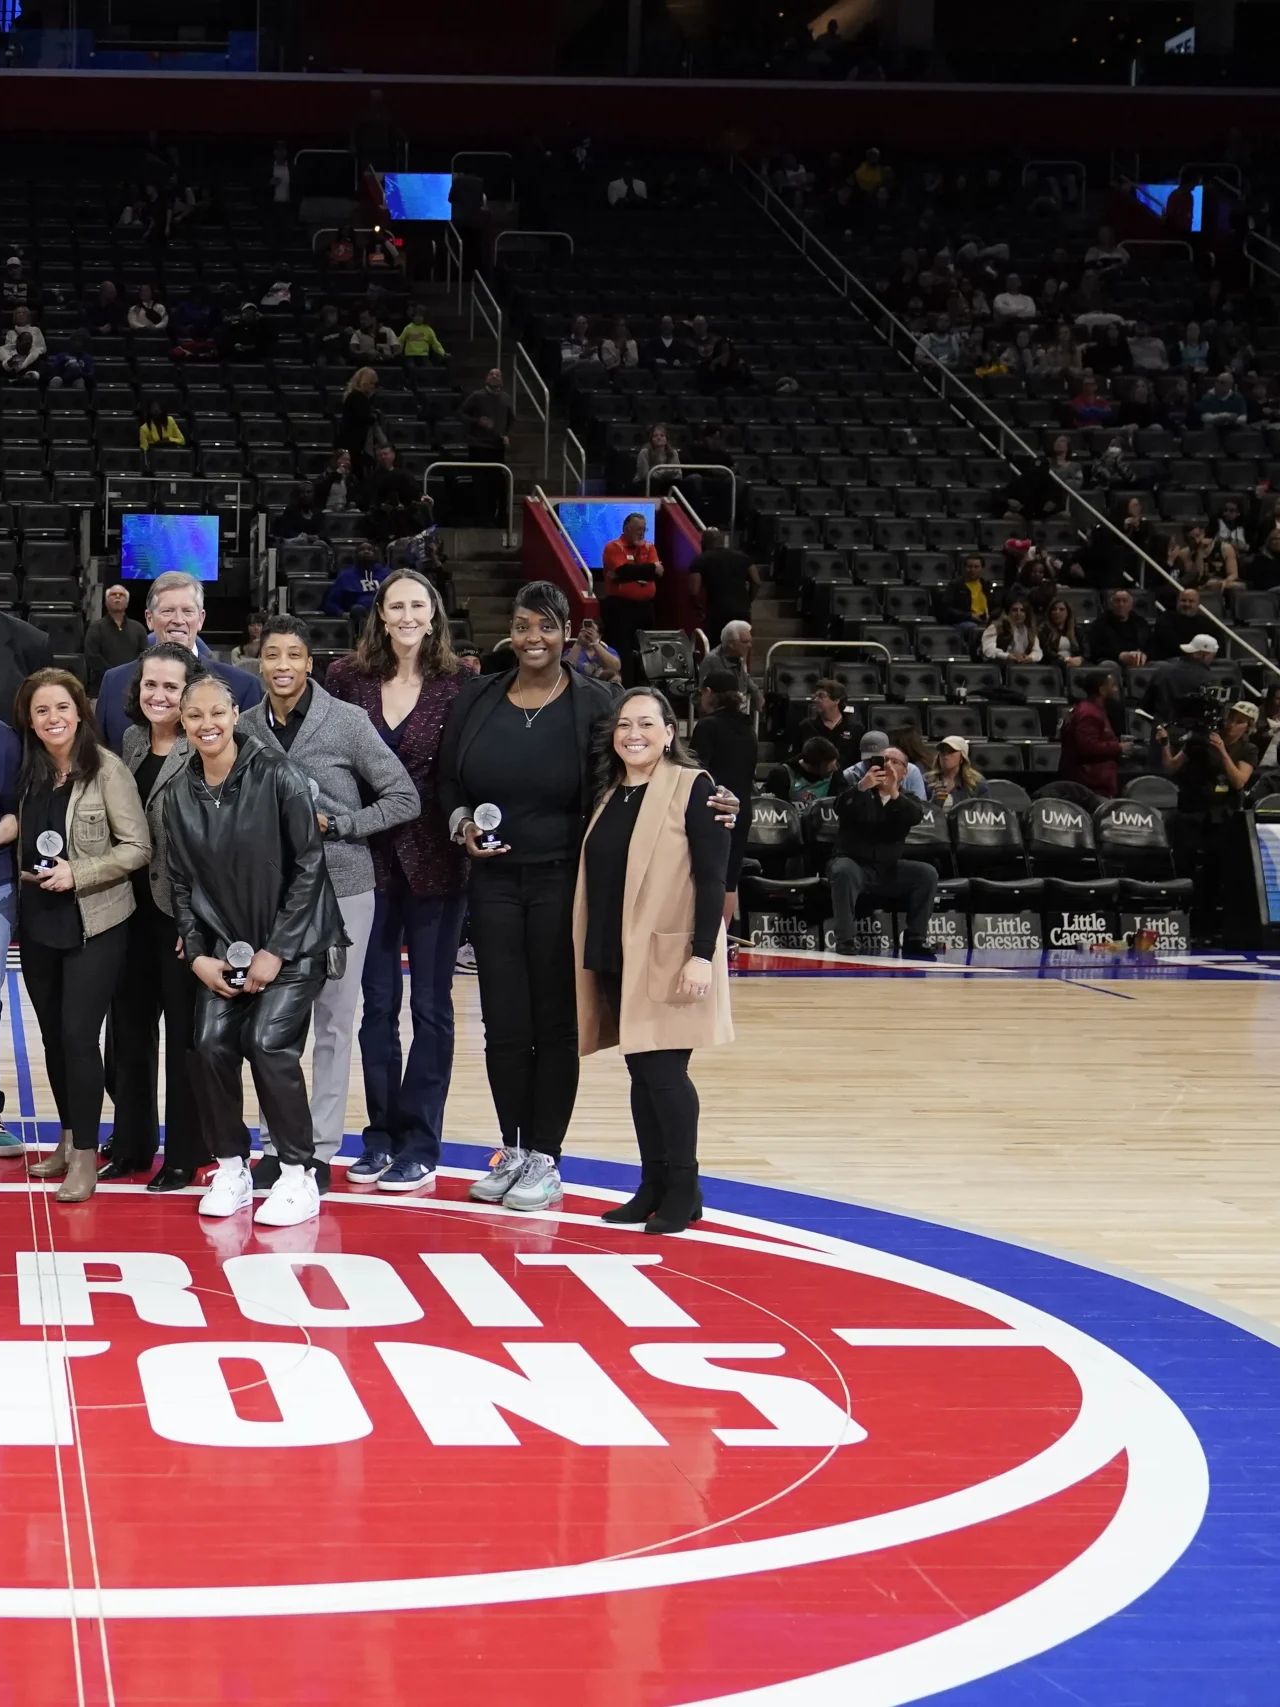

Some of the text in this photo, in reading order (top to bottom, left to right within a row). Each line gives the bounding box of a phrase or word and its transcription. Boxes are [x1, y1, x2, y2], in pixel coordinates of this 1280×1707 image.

[965, 811, 1006, 825] UWM
[1042, 809, 1082, 828] UWM
[1111, 811, 1153, 827] UWM
[761, 915, 807, 934] Little
[853, 916, 882, 934] ttle
[927, 916, 956, 934] ttle
[985, 917, 1031, 935] Little
[1061, 912, 1106, 931] Little
[750, 929, 816, 949] Caesars
[824, 930, 890, 949] Csars
[974, 932, 1039, 949] Caesars
